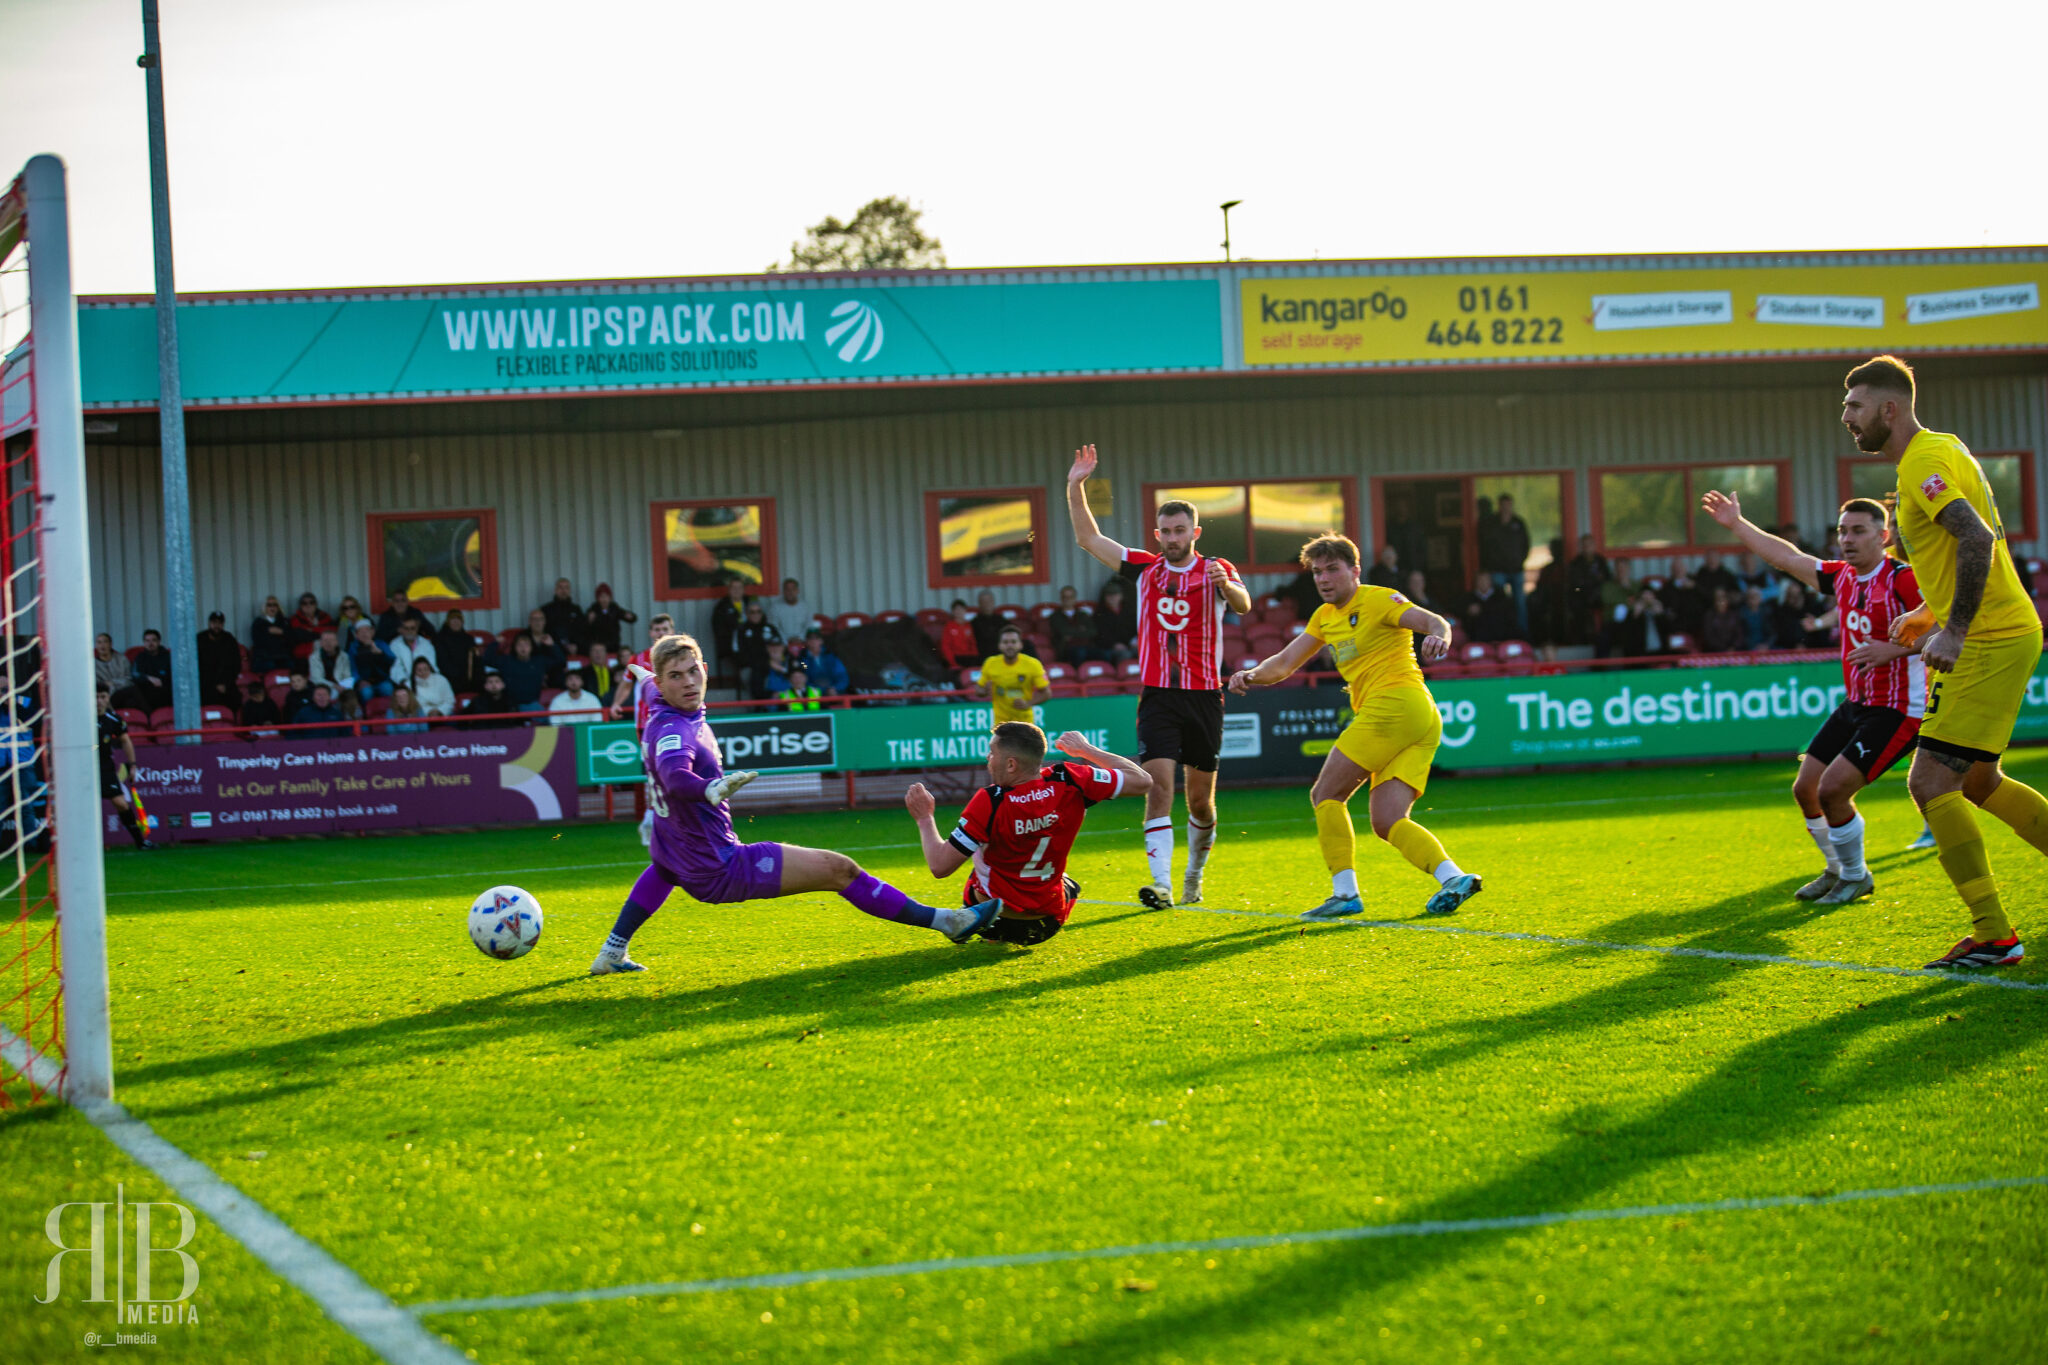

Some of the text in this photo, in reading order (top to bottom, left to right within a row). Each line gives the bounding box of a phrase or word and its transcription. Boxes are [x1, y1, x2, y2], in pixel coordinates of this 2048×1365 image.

[1261, 290, 1407, 330] kangaroo
[1458, 285, 1530, 312] 0161
[1608, 299, 1725, 319] Household Storage
[1769, 300, 1876, 321] Student Storage
[1919, 290, 2031, 317] Business Storage
[443, 302, 805, 351] WWW.IPSPACK.COM
[1426, 317, 1564, 346] 464 8222
[1261, 331, 1363, 351] self storage
[496, 348, 758, 377] FLEXIBLE PACKAGING SOLUTIONS
[1157, 597, 1191, 616] ao
[1846, 609, 1873, 635] ao
[1507, 691, 1594, 731] The
[1925, 682, 1944, 714] 5
[951, 708, 995, 731] HER
[1279, 709, 1335, 721] FOLLOW
[217, 743, 508, 771] Timperley Care Home & Four Oaks Care Home
[887, 739, 925, 762] THE
[931, 735, 990, 760] NATIO
[135, 764, 203, 785] Kingsley
[218, 771, 471, 797] Let Our Family Take Care of Yours
[1008, 786, 1055, 804] worlday
[218, 811, 240, 823] Call
[242, 809, 268, 822] 0161
[270, 808, 291, 821] 768
[293, 807, 322, 820] 6302
[324, 808, 336, 818] to
[338, 804, 364, 816] book
[366, 805, 374, 815] a
[375, 803, 398, 815] visit
[1014, 812, 1060, 835] BAINES
[1019, 837, 1056, 881] 4
